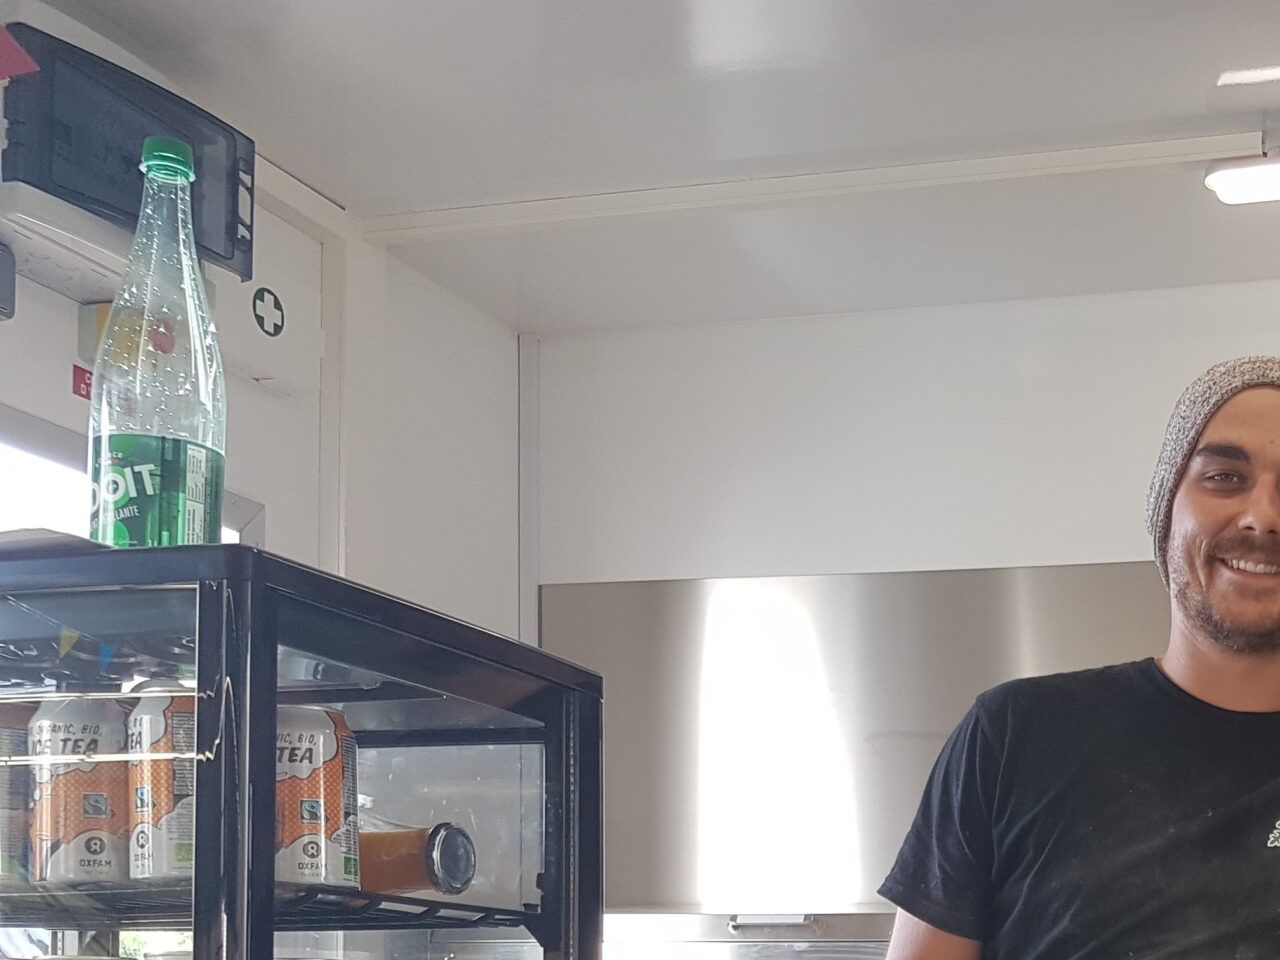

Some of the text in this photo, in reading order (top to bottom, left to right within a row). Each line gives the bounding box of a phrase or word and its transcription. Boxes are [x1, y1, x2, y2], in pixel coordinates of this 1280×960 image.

[60, 738, 99, 754] TEA
[277, 747, 314, 764] TEA
[79, 859, 112, 867] OXFAM
